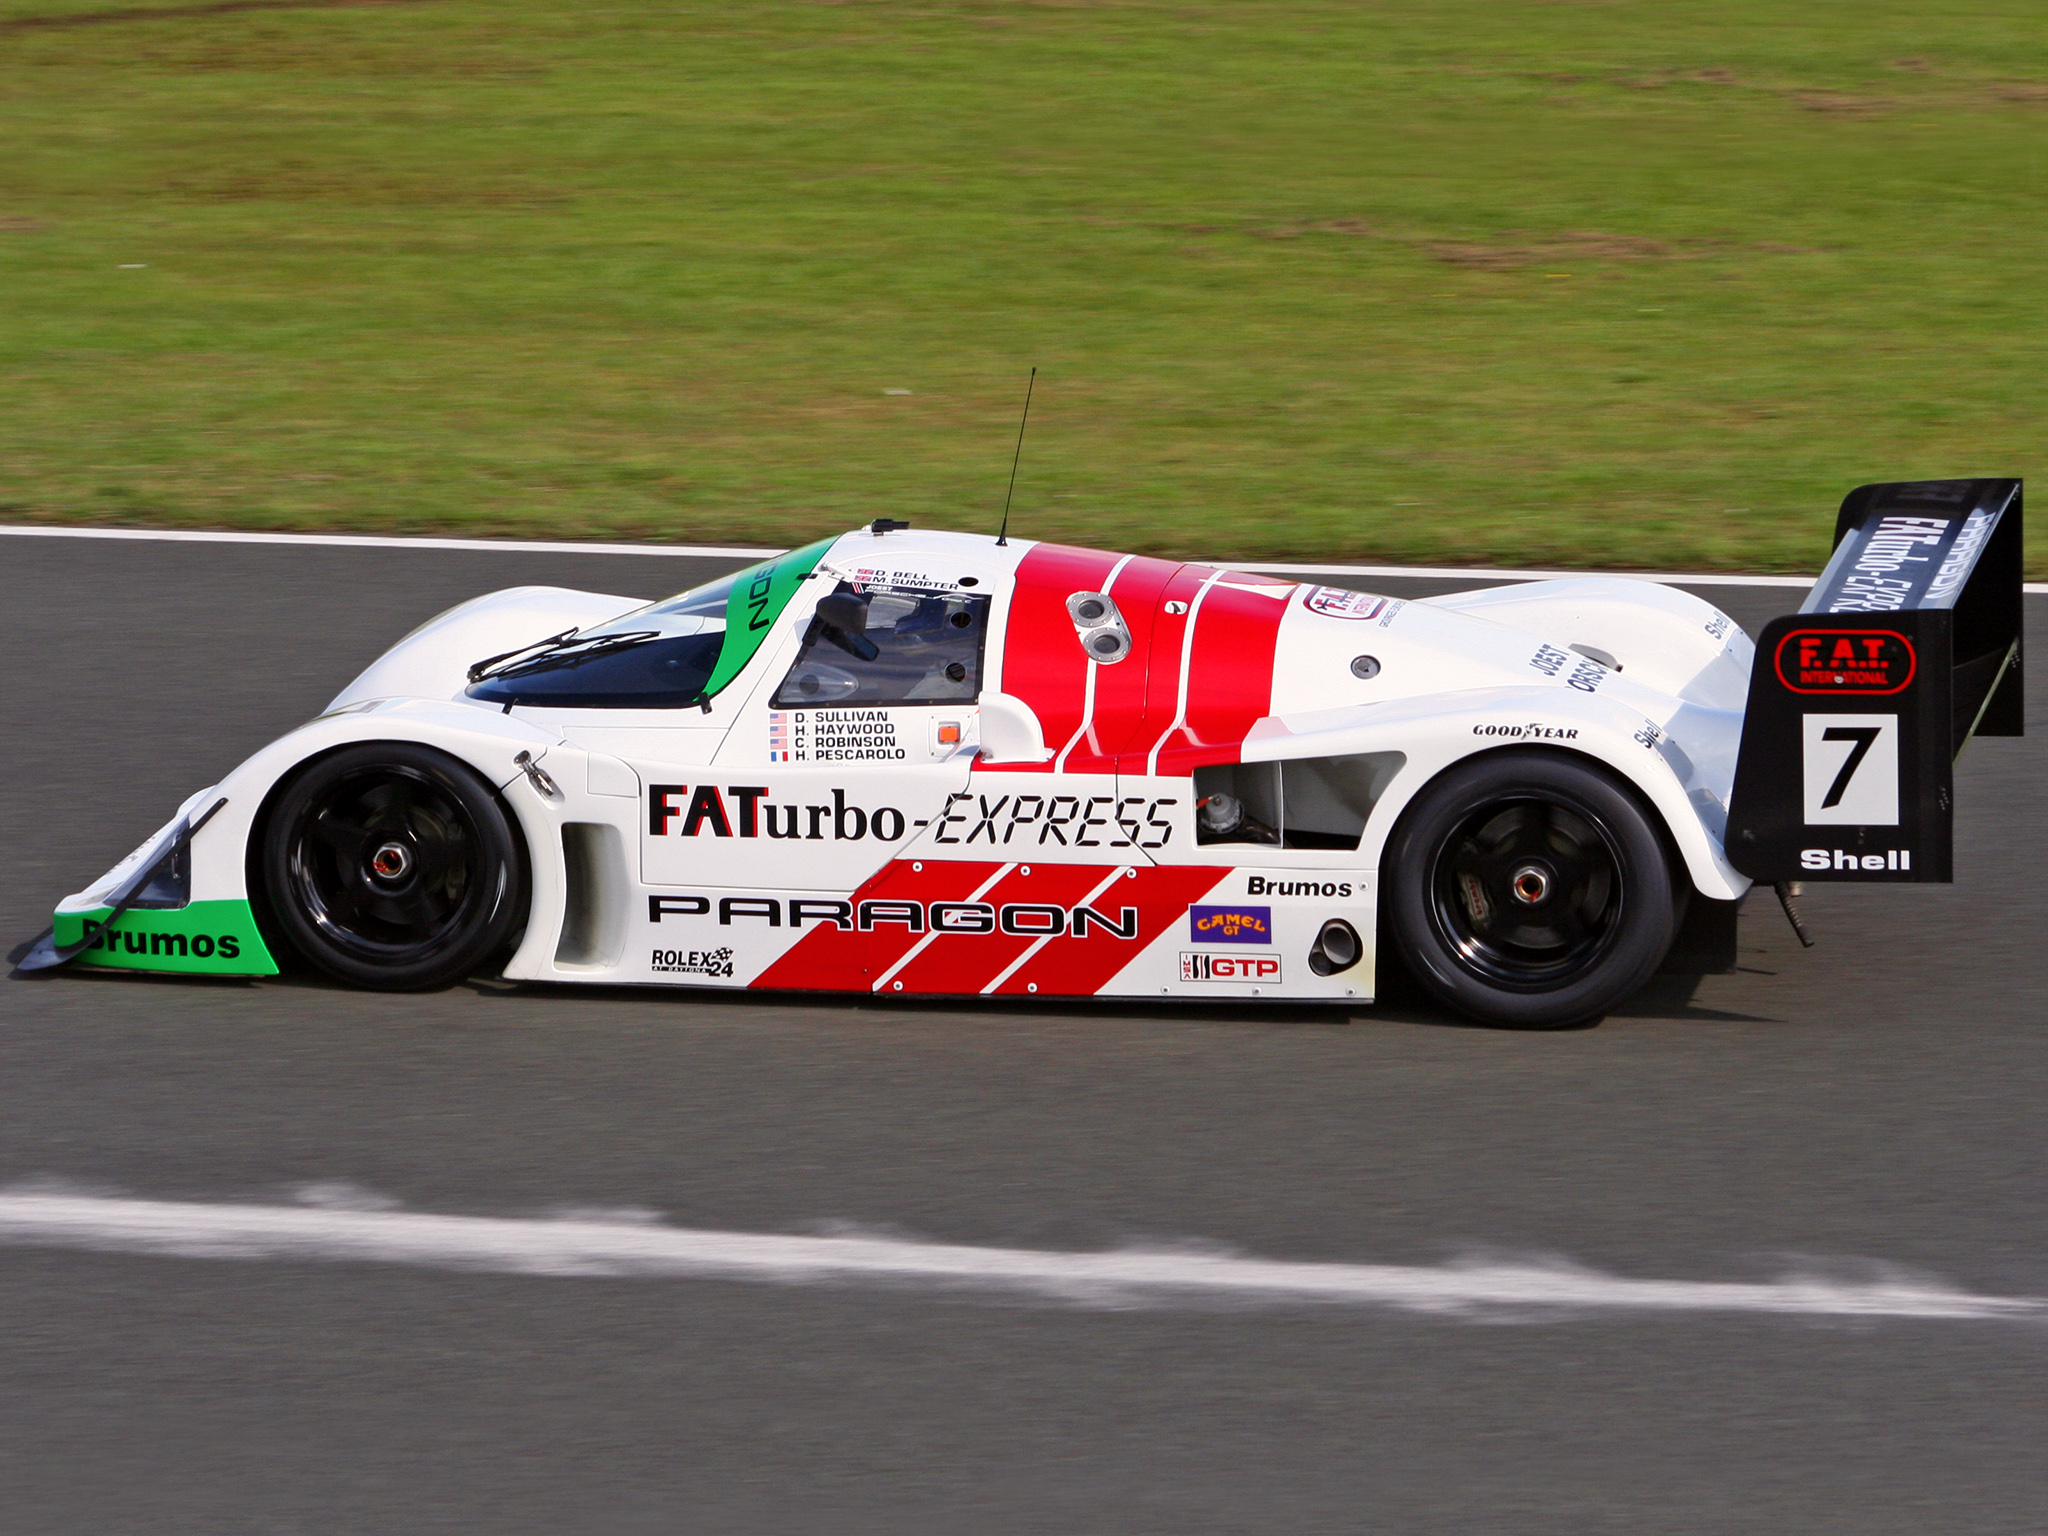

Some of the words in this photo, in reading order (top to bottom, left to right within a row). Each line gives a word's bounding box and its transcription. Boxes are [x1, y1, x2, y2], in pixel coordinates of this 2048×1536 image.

[1829, 516, 1950, 613] FATurbo-EXPR
[872, 576, 888, 584] M.
[890, 578, 959, 590] SUMPTER
[893, 571, 930, 580] BELL
[1705, 610, 1731, 640] Shell
[1529, 643, 1570, 676] JOEST
[1800, 638, 1889, 668] F.A.T.
[1801, 670, 1889, 685] INTERNATIONAL
[795, 712, 809, 723] D.
[815, 711, 888, 723] SULLIVAN
[795, 725, 810, 736] H.
[815, 723, 895, 735] HAYWOOD
[1633, 717, 1662, 749] Shell
[795, 738, 810, 748] C.
[815, 736, 896, 748] ROBINSON
[795, 750, 810, 760] H.
[815, 748, 906, 760] PESCAROLO
[1820, 727, 1882, 810] 7
[1800, 849, 1911, 871] Shell
[1247, 876, 1352, 897] Brumos
[648, 895, 1138, 939] PARAGON
[1196, 914, 1266, 932] CAMEL
[82, 918, 240, 959] Brumos
[1223, 925, 1240, 935] GT
[652, 949, 712, 967] ROLEX
[708, 961, 734, 977] 24
[1211, 958, 1279, 977] GTP
